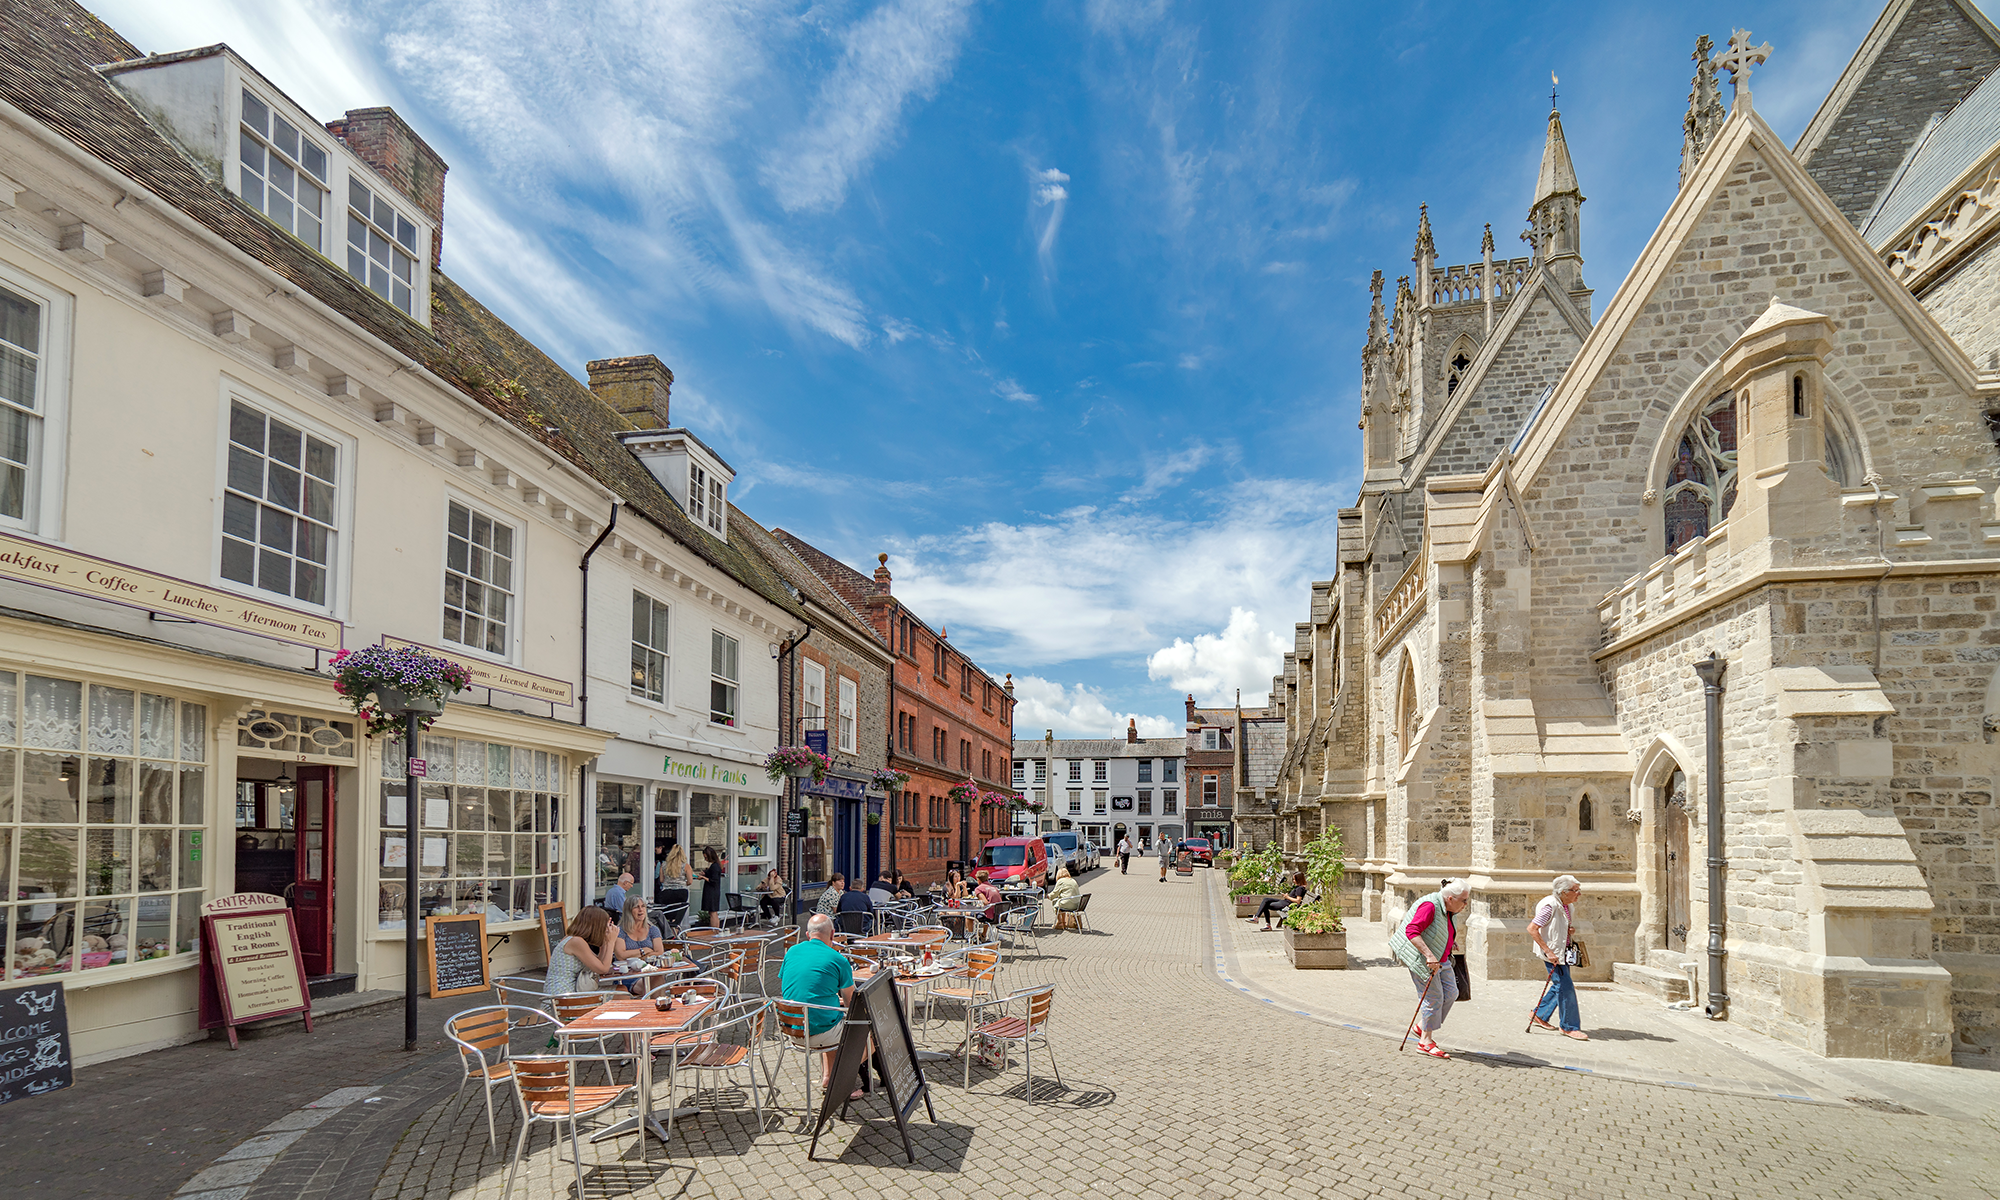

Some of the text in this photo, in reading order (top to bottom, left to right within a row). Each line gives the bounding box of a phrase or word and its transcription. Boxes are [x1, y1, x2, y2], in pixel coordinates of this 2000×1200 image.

[0, 552, 327, 640] akfast Coffee Lunches Afternoon Teas
[466, 666, 566, 696] Rooms Licensed Restaurant
[662, 755, 748, 786] French Franks
[1200, 810, 1224, 819] mia
[216, 894, 280, 908] ENTRANCE
[226, 920, 277, 931] Traditional
[236, 931, 271, 941] English
[251, 941, 280, 950] Rooms
[247, 964, 275, 972] Breakfast
[241, 976, 266, 985] Morning
[237, 989, 269, 998] Homemade
[247, 1000, 276, 1009] Afternoon
